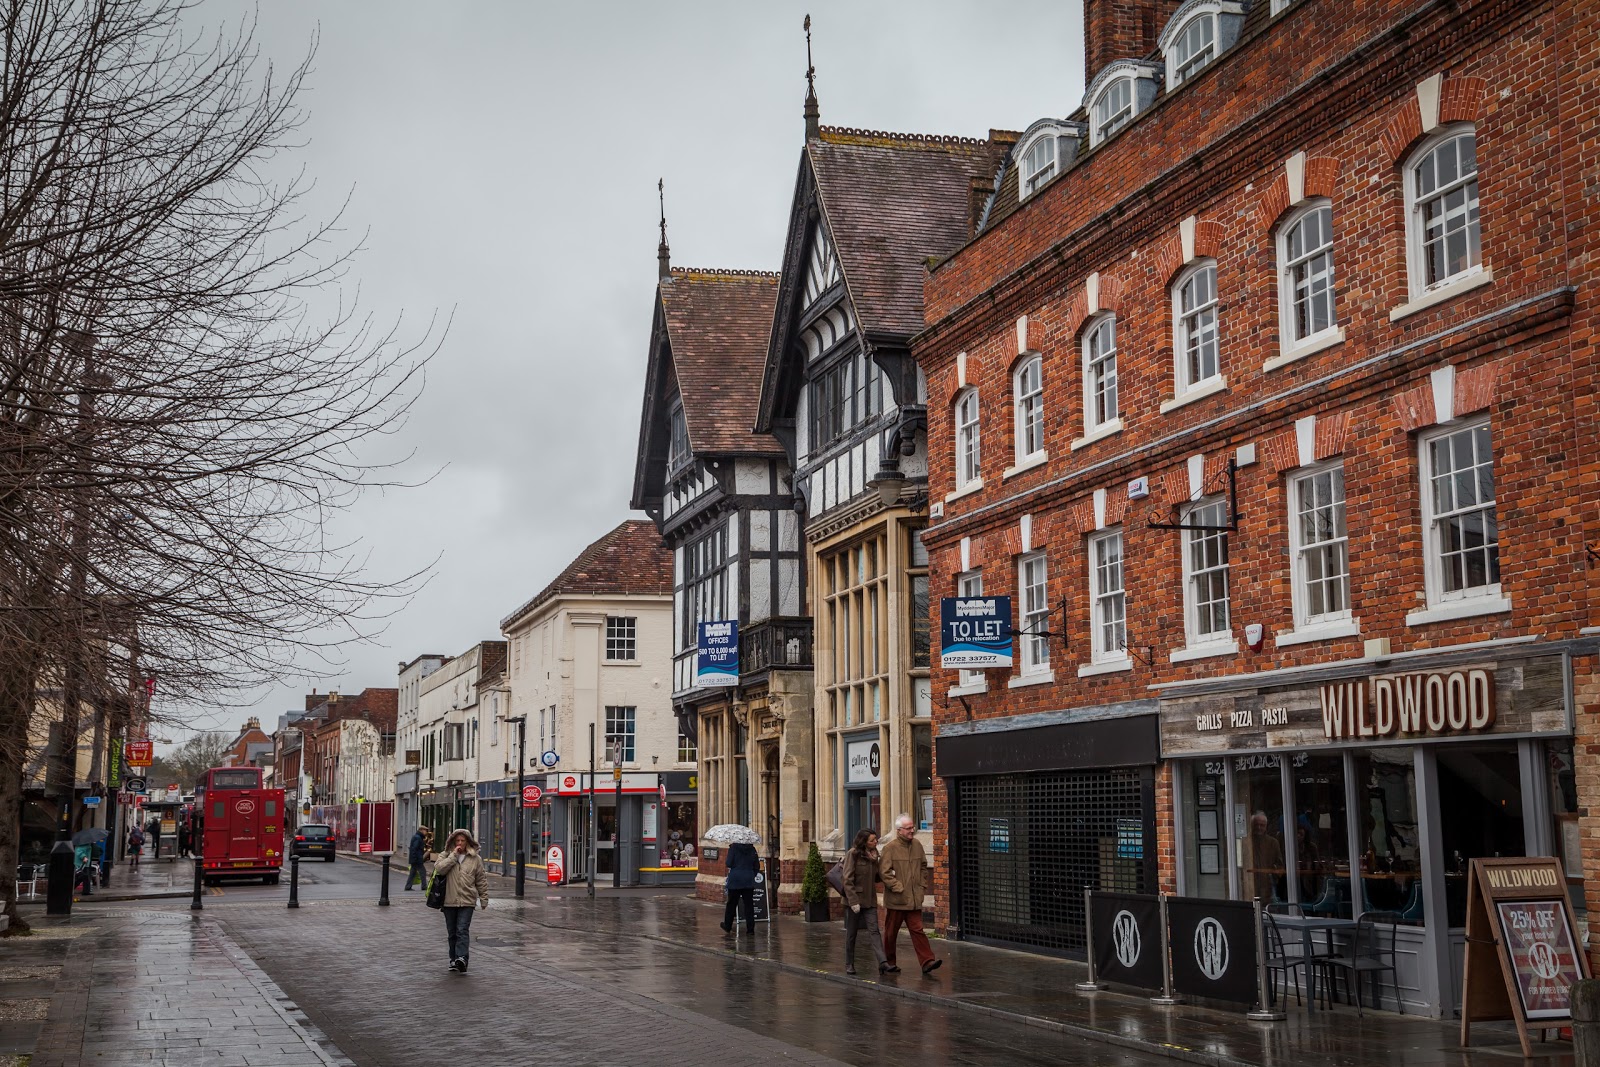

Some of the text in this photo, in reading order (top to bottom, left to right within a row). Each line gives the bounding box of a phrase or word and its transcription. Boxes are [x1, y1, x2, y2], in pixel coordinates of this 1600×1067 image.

[949, 620, 1003, 637] TO LET
[1320, 669, 1494, 738] WILDWOOD
[1196, 707, 1288, 731] GRILLS PIZZA PASTA
[851, 754, 868, 768] gallery
[1486, 868, 1558, 888] WILDWOOD
[1510, 910, 1556, 929] 25% OFF
[1528, 986, 1538, 995] FOR
